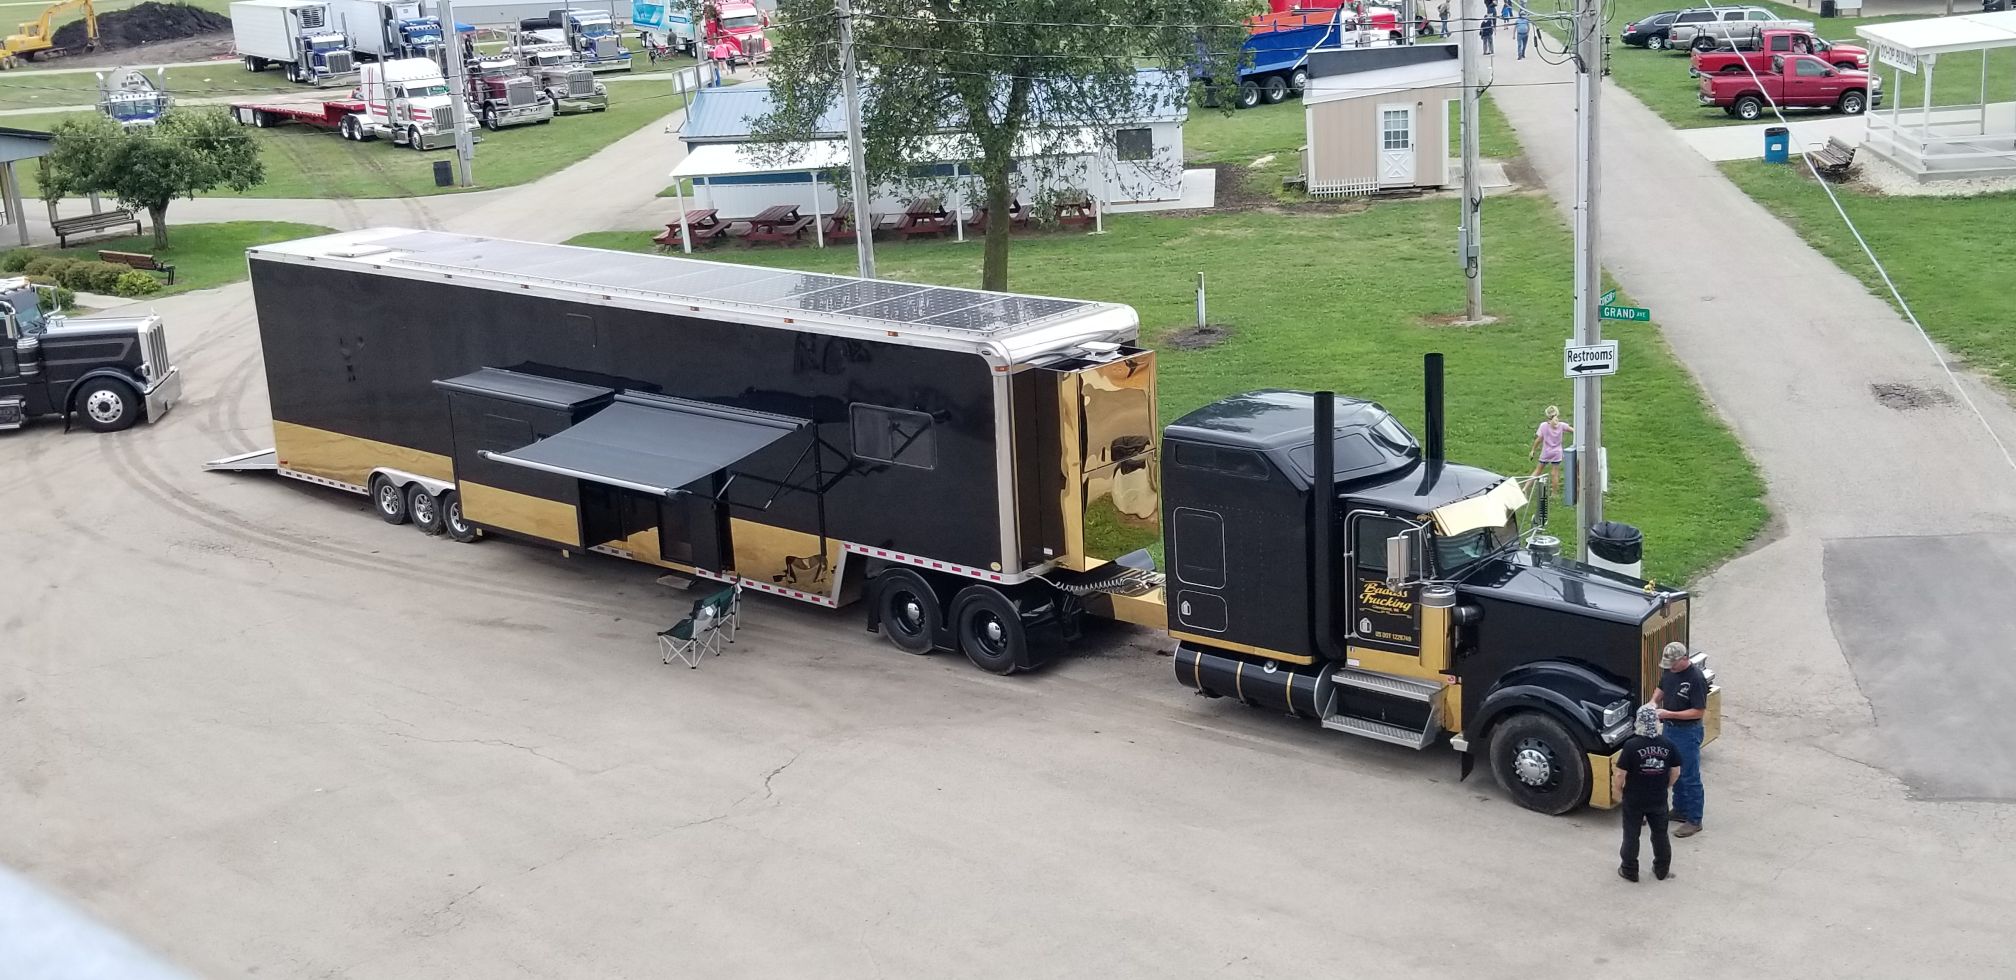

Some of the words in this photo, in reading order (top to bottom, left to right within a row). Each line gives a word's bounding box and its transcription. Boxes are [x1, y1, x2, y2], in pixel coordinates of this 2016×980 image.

[1896, 49, 1916, 69] BUILDING
[1604, 307, 1635, 319] GRAND
[1567, 350, 1613, 363] Restrooms
[1360, 592, 1412, 612] Trucking
[1637, 746, 1670, 757] DIRKS
